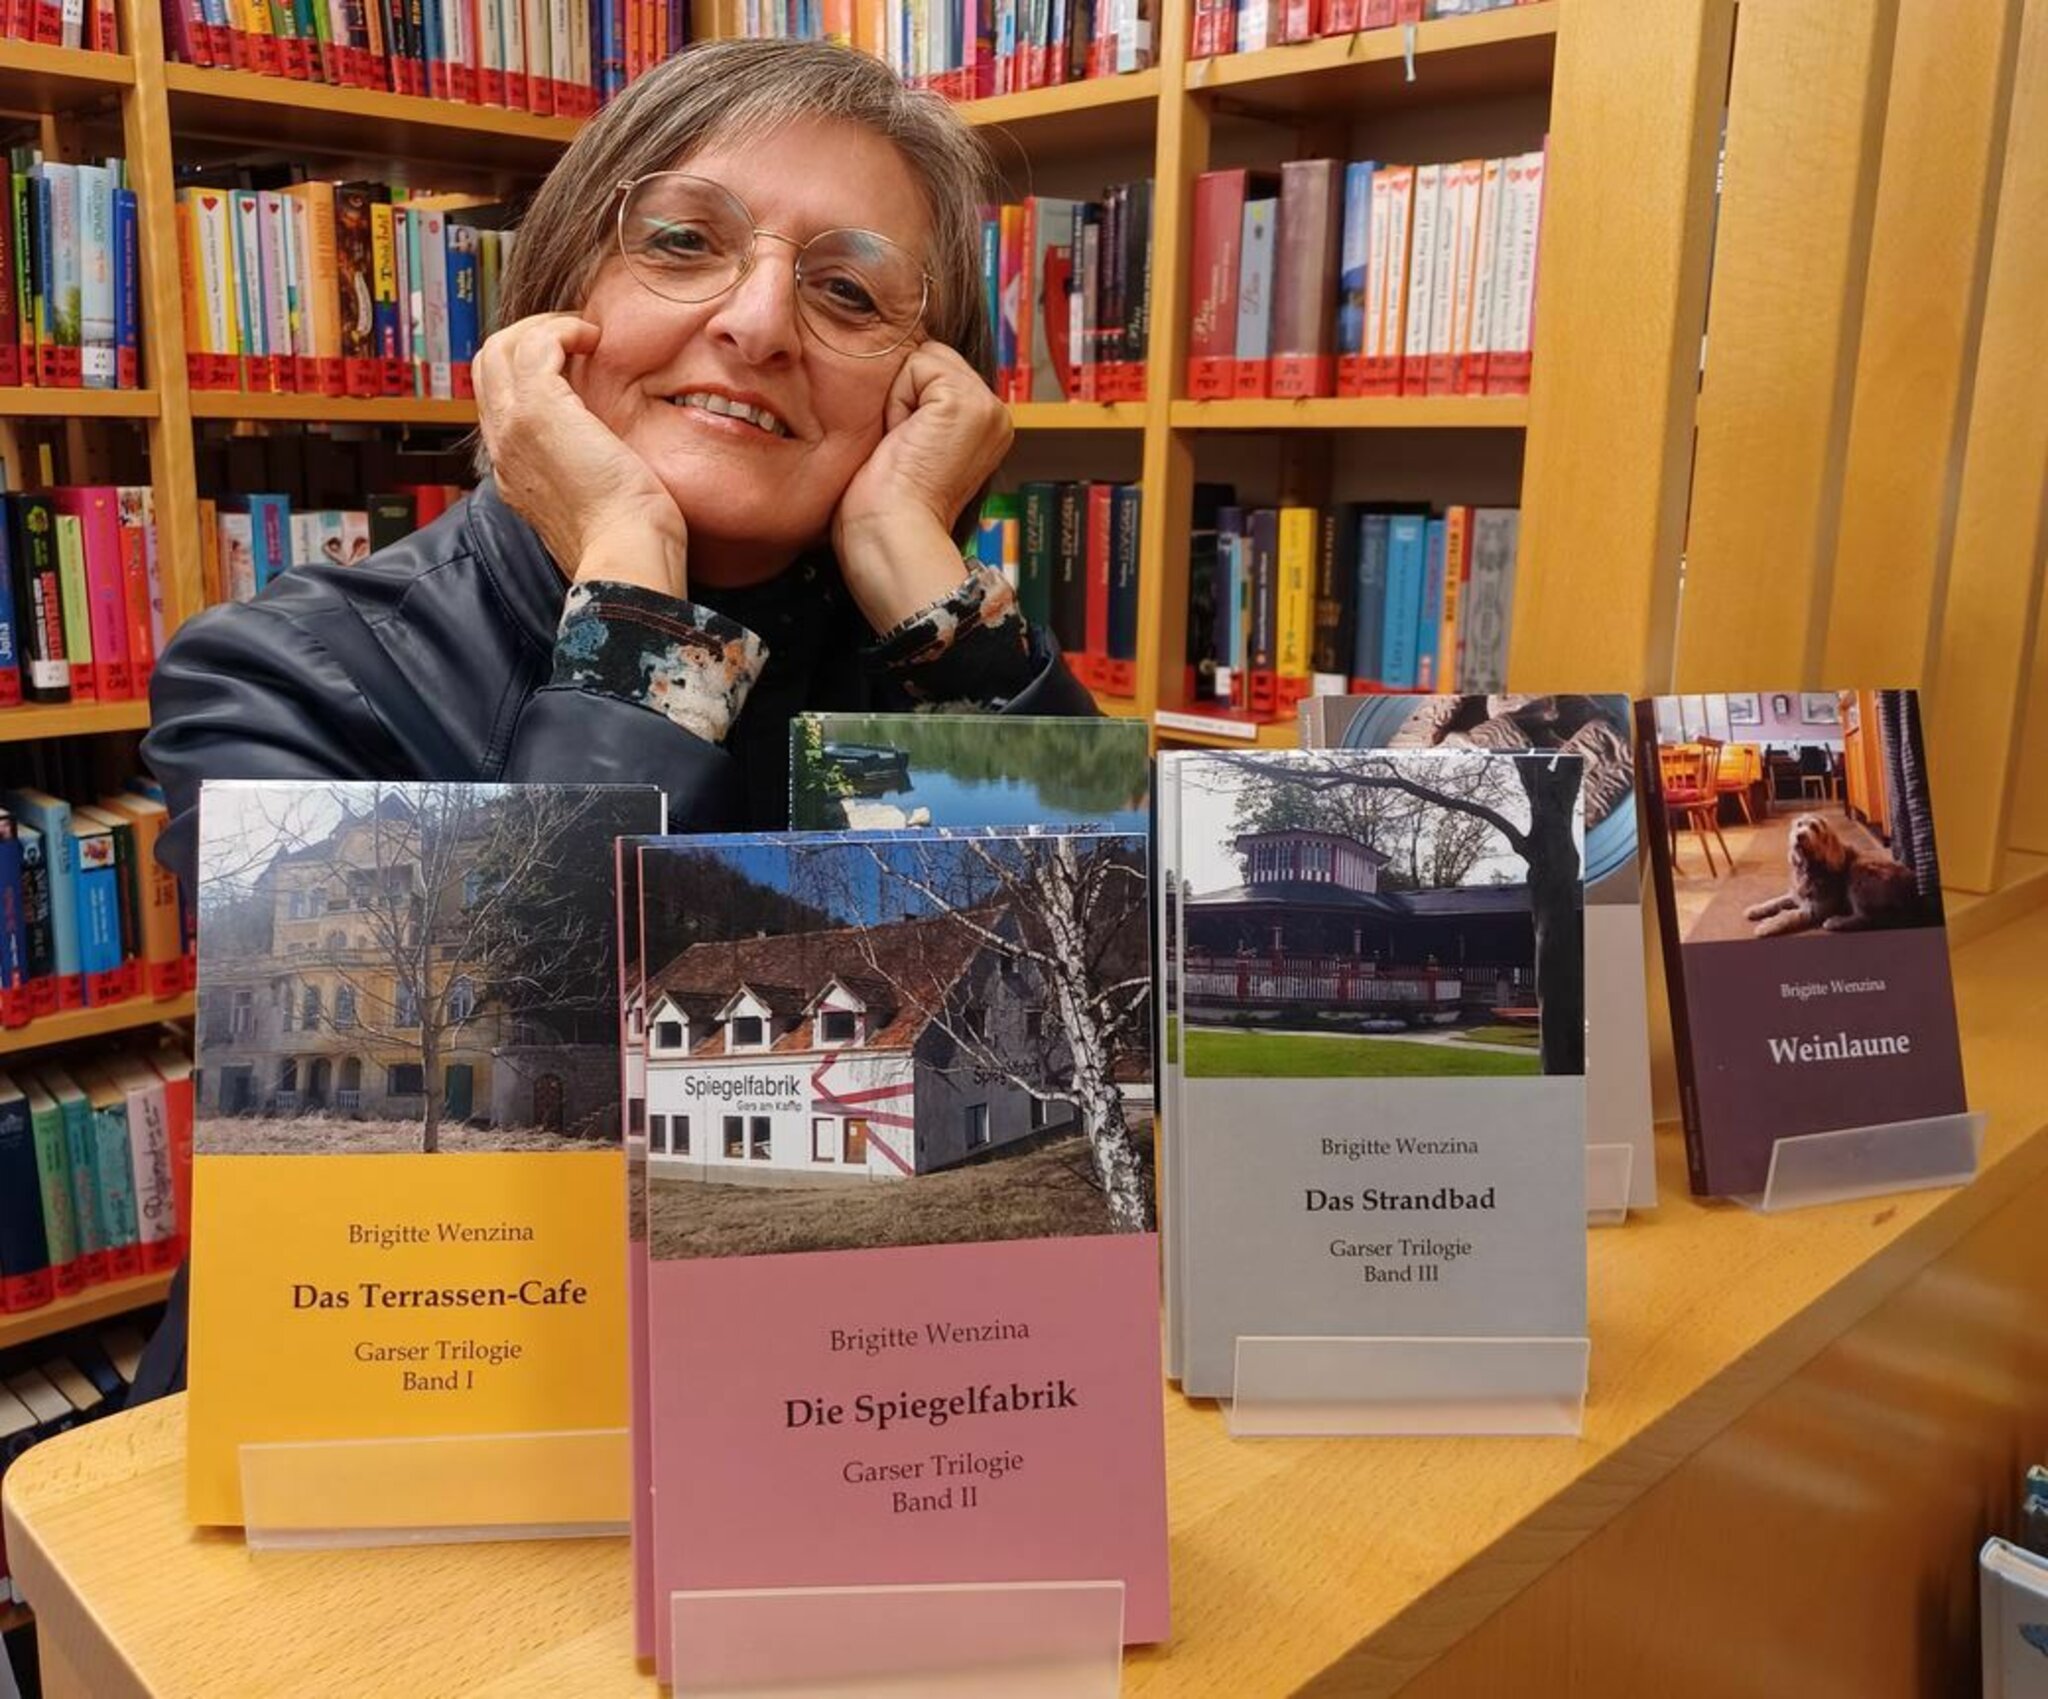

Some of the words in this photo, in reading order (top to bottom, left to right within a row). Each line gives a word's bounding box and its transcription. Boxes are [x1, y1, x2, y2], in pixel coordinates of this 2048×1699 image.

[1780, 981, 1828, 1001] Brigitte
[1830, 977, 1886, 994] Wenzina
[1767, 1031, 1911, 1064] Weinlaune
[684, 1075, 801, 1101] Spiegelfabrik
[1321, 1137, 1391, 1161] Brigitte
[1395, 1137, 1479, 1155] Wenzina
[1305, 1189, 1354, 1211] Das
[1362, 1187, 1496, 1211] Strandbad
[349, 1223, 430, 1249] Brigitte
[437, 1222, 534, 1243] Wenzina
[1329, 1239, 1393, 1257] Garser
[1397, 1238, 1472, 1261] Trilogie
[1364, 1264, 1412, 1282] Band
[1418, 1264, 1439, 1282] III
[293, 1284, 349, 1309] Das
[359, 1280, 587, 1308] Terrassen-Cafe
[831, 1326, 919, 1357] Brigitte
[925, 1319, 1030, 1345] Wenzina
[354, 1342, 429, 1362] Garser
[435, 1340, 522, 1365] Trilogie
[402, 1370, 458, 1392] Band
[466, 1370, 474, 1390] I
[784, 1397, 844, 1428] Die
[855, 1380, 1079, 1430] Spiegelfabrik
[843, 1460, 924, 1484] Garser
[930, 1450, 1024, 1479] Trilogie
[892, 1488, 952, 1513] Band
[961, 1486, 978, 1507] II
